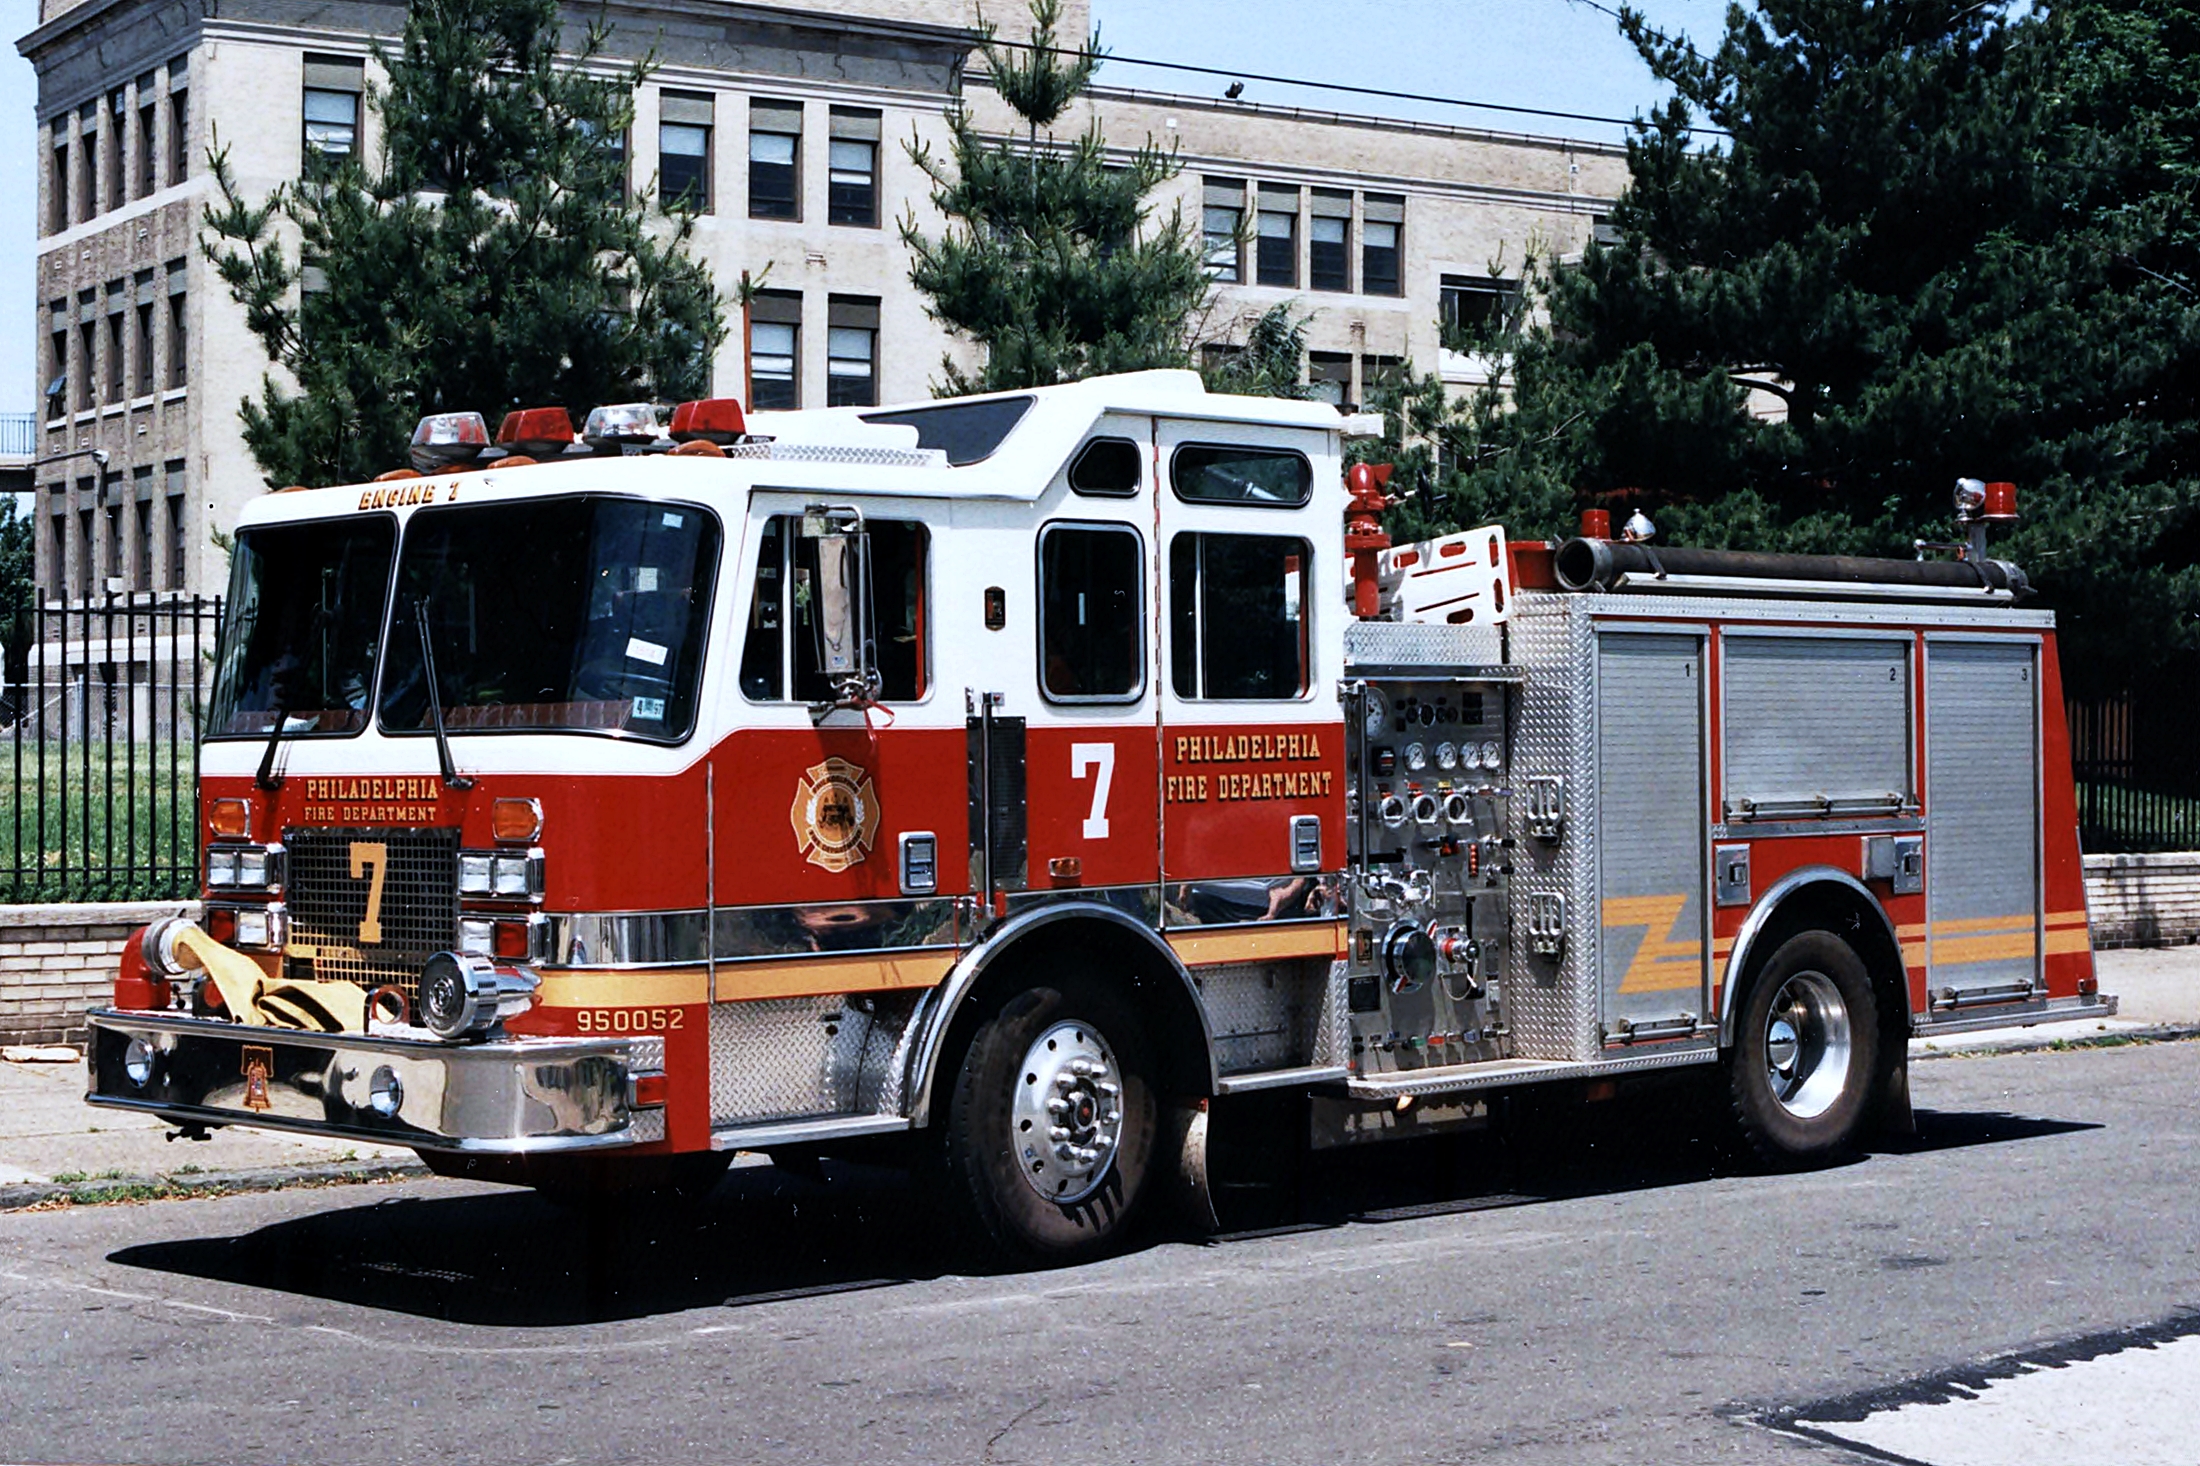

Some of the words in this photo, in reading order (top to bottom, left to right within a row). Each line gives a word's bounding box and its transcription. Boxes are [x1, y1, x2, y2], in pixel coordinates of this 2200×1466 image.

[358, 484, 436, 510] ENGINE
[448, 480, 460, 502] 7
[1684, 663, 1690, 677] 1
[1889, 667, 1897, 681] 2
[2021, 668, 2028, 681] 3
[1176, 734, 1321, 763] PHILADELPHIA
[307, 778, 439, 801] PHILADELPHIA
[1071, 742, 1116, 840] 7
[1167, 775, 1207, 801] FIRE
[1219, 771, 1332, 801] DEPARTMENT
[304, 806, 336, 822] FIRE
[343, 806, 437, 822] DEPARTMENT
[349, 841, 388, 944] 7
[577, 1008, 685, 1032] 950052
